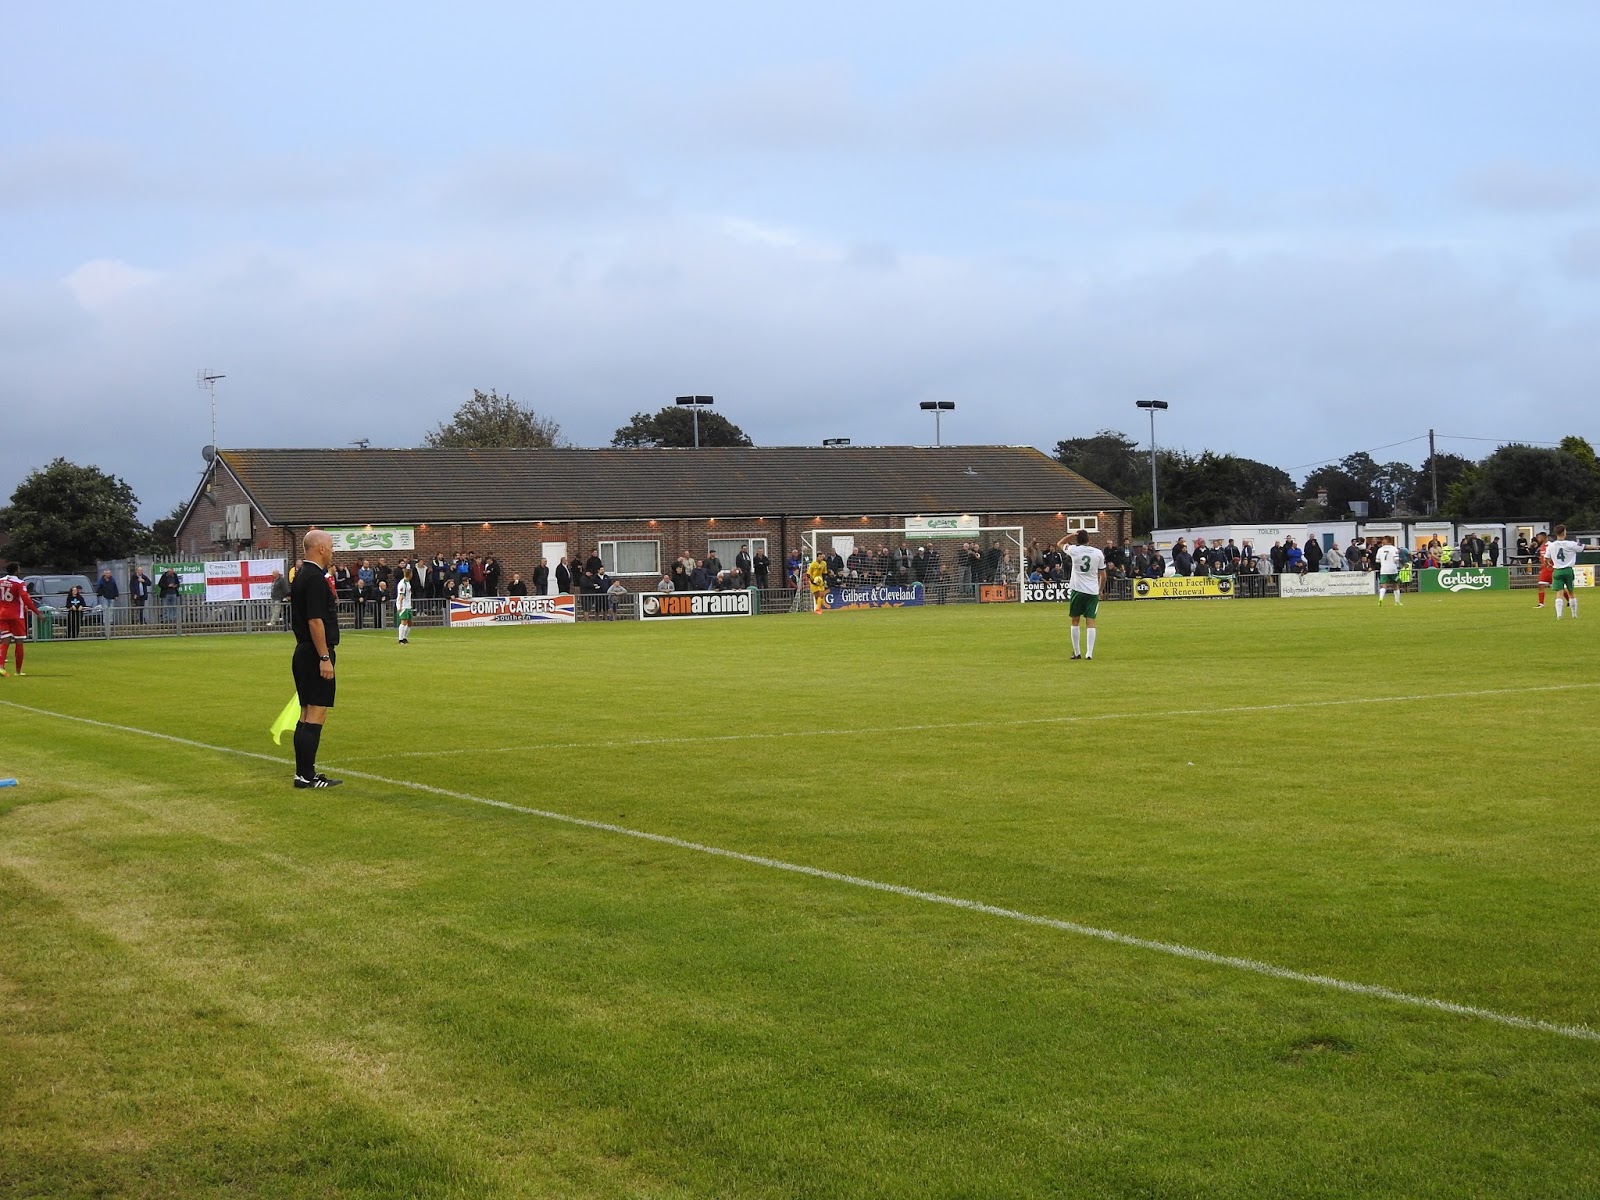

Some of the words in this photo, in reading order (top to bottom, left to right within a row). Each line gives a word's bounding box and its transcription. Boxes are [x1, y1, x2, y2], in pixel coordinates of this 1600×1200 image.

[1383, 551, 1390, 560] 7
[1556, 548, 1566, 562] 4
[184, 565, 201, 573] Regis
[1080, 555, 1091, 572] 3
[1152, 579, 1183, 588] Kitchen
[1186, 577, 1215, 586] Facelift
[1437, 568, 1492, 589] Carlsberg
[0, 586, 14, 602] 16
[842, 588, 869, 602] Gilbert
[871, 588, 878, 600] &
[880, 585, 916, 600] Cleveland
[1024, 588, 1072, 600] ROCKS
[1172, 587, 1205, 596] Renewal
[1283, 586, 1309, 594] Hollymead
[658, 594, 749, 614] vanarama
[826, 594, 834, 604] G
[470, 601, 506, 614] COMFY
[509, 600, 555, 613] CARPETS
